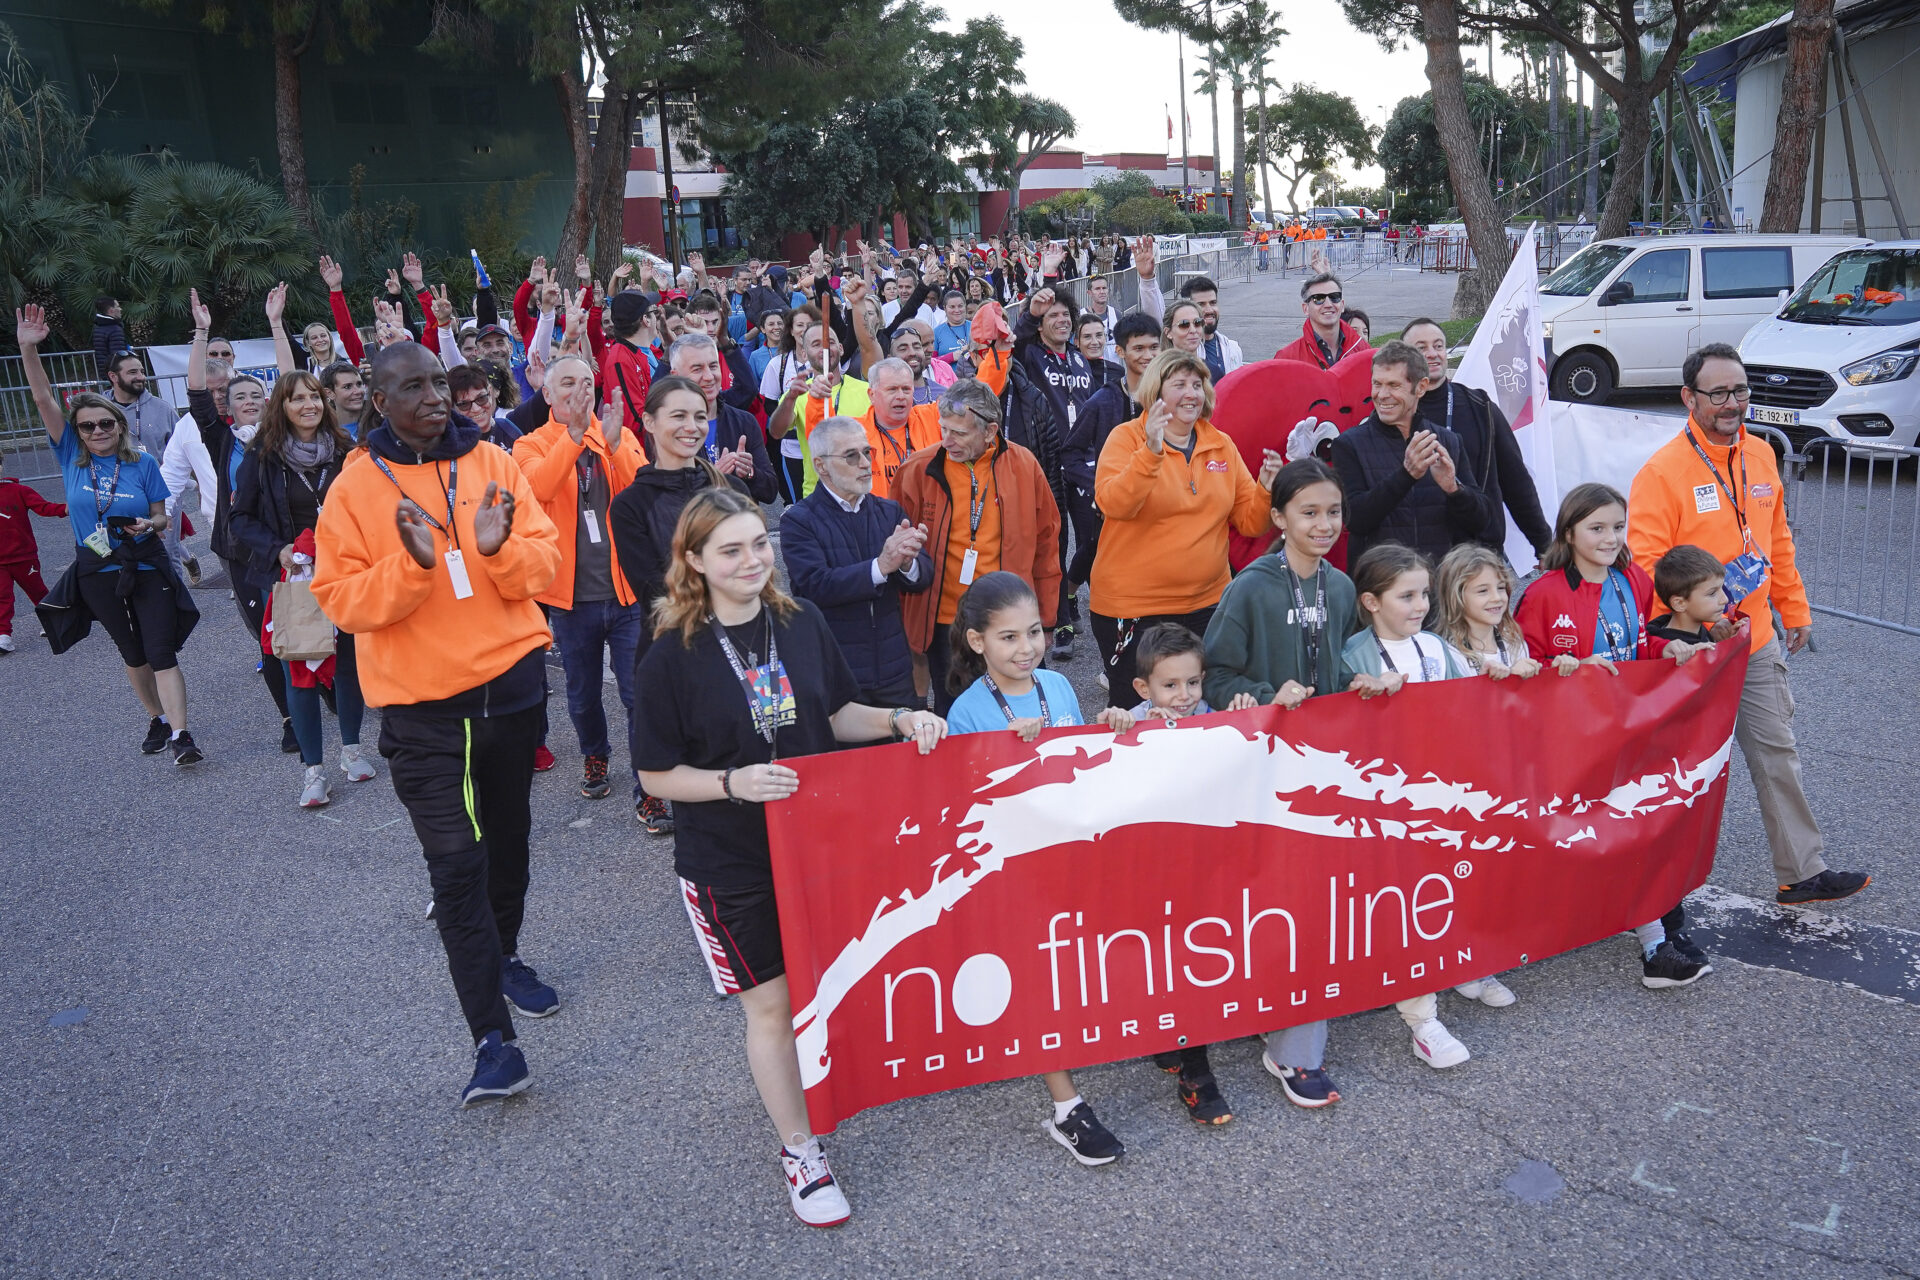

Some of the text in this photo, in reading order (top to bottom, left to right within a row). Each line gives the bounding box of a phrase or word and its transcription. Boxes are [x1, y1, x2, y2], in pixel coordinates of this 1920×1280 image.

[1755, 409, 1794, 423] FE-192-XY
[719, 638, 745, 681] MONTE-CARLO
[751, 699, 772, 744] MONTE-CARLO
[884, 952, 1012, 1042] no
[1038, 888, 1297, 1012] finish
[884, 947, 1473, 1079] TOUJOURS PLUS LOIN
